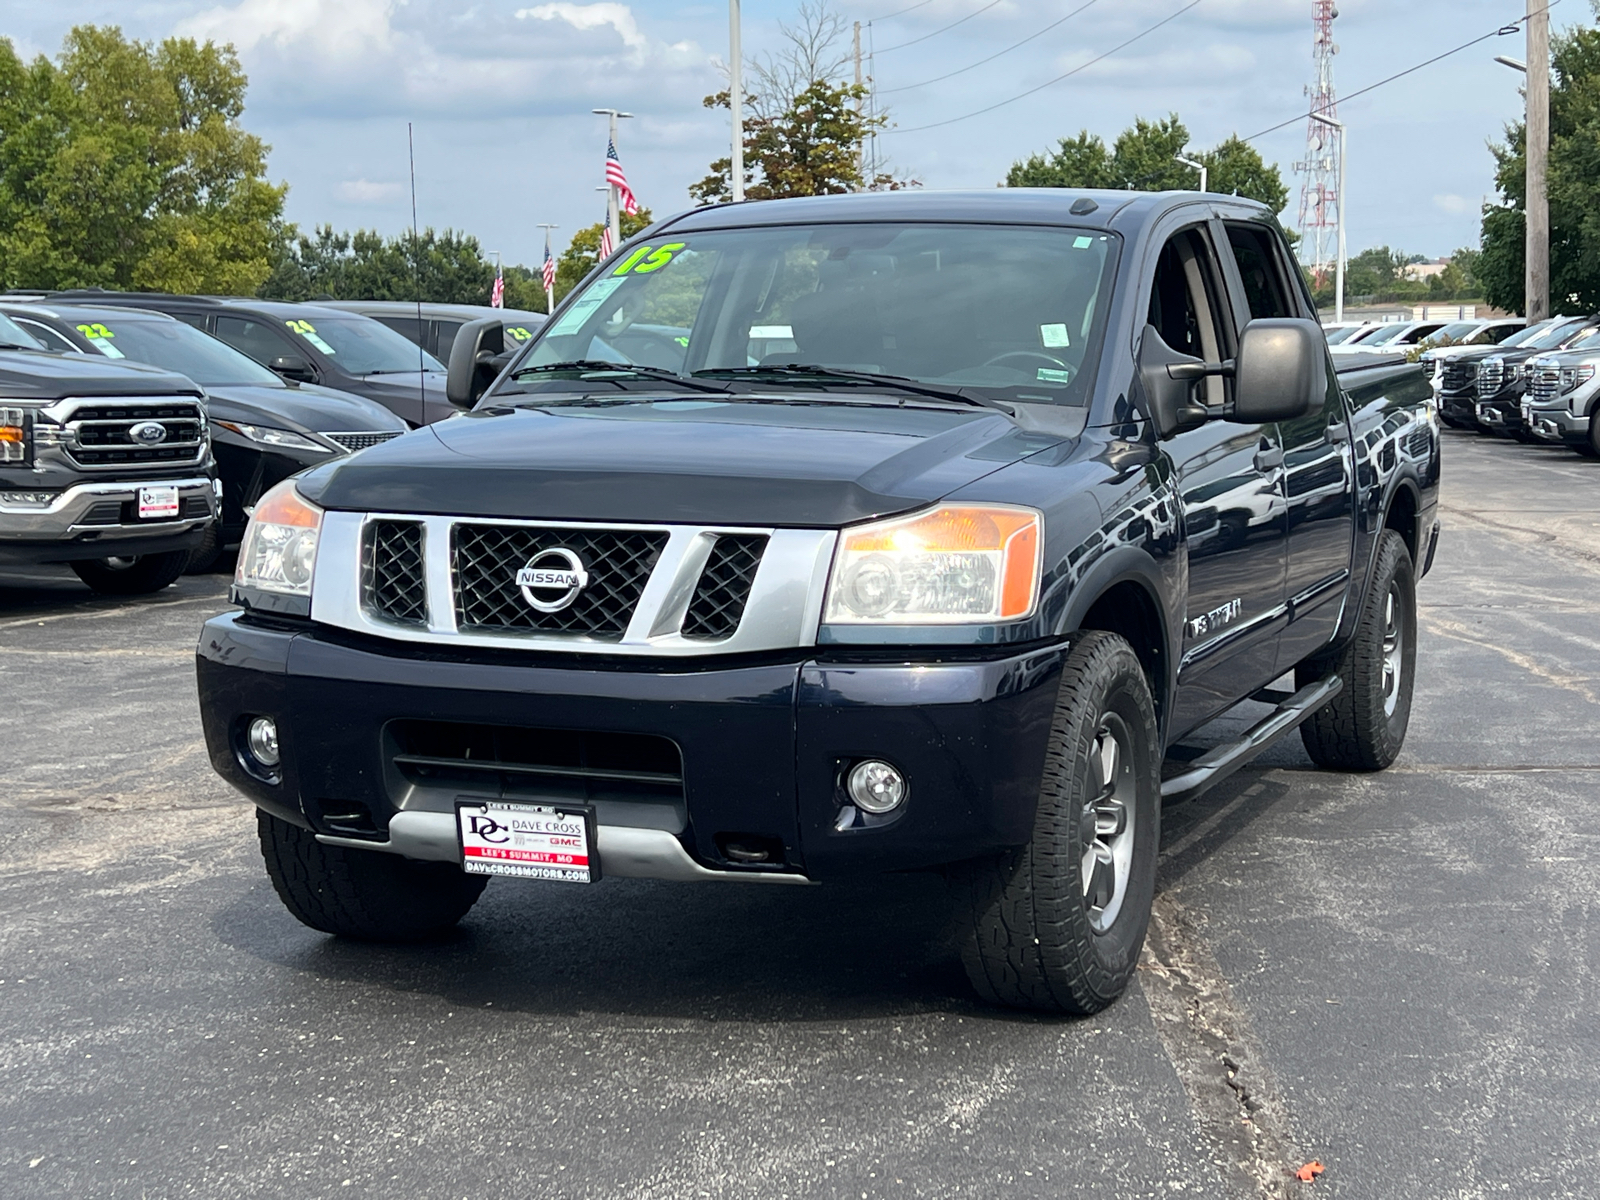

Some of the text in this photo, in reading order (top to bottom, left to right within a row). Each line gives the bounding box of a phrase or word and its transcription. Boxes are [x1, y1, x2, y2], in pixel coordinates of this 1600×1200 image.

[612, 242, 686, 276] 15
[76, 323, 115, 339] 22
[521, 572, 579, 584] NISSAN
[512, 820, 582, 834] DAVE CROSS
[549, 837, 582, 847] GMC
[481, 848, 573, 863] LEE'S SUMMIT, MO
[466, 862, 588, 881] DAVECROSSMOTORS.COM
